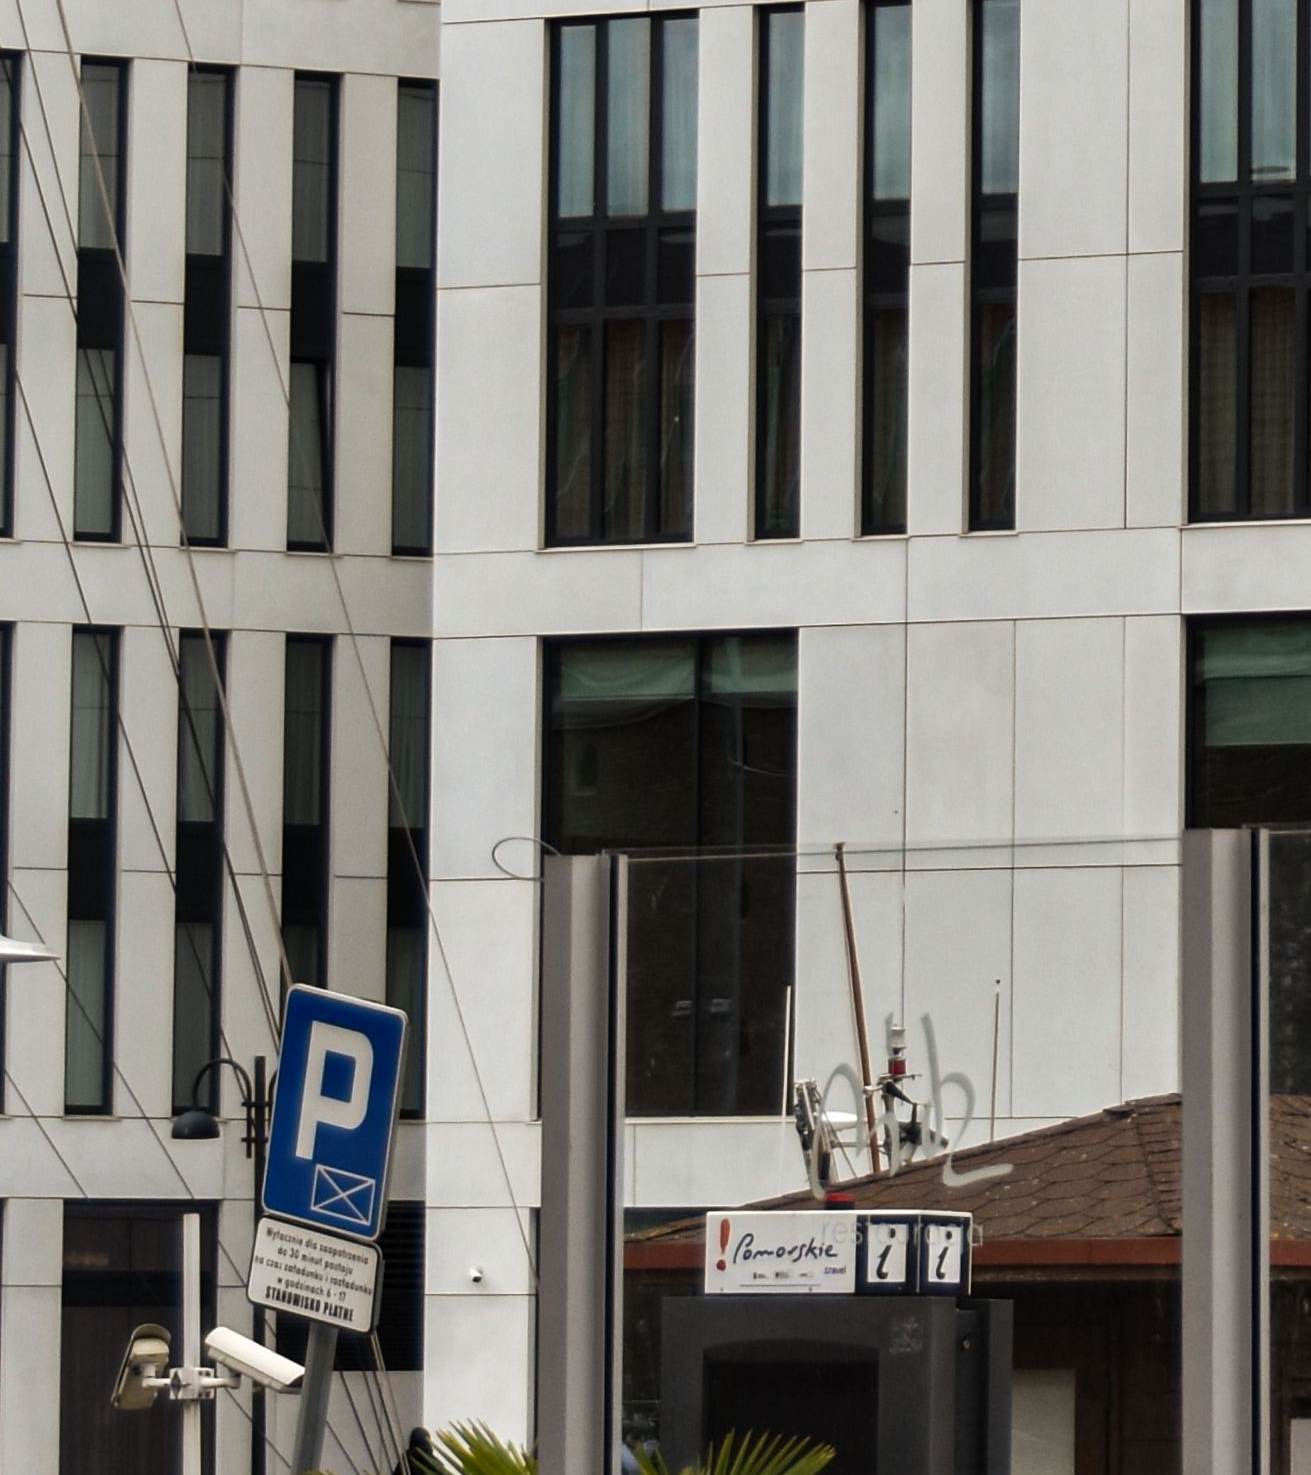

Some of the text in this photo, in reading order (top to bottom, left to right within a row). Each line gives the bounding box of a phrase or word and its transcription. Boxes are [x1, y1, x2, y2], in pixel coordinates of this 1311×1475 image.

[295, 1019, 374, 1161] P
[277, 1247, 354, 1277] do 30 minut postoju
[733, 1233, 838, 1264] Pomorskie
[266, 1258, 282, 1270] czas
[285, 1277, 325, 1297] godzinach
[265, 1285, 355, 1322] STANOWISKO PŁATNE
